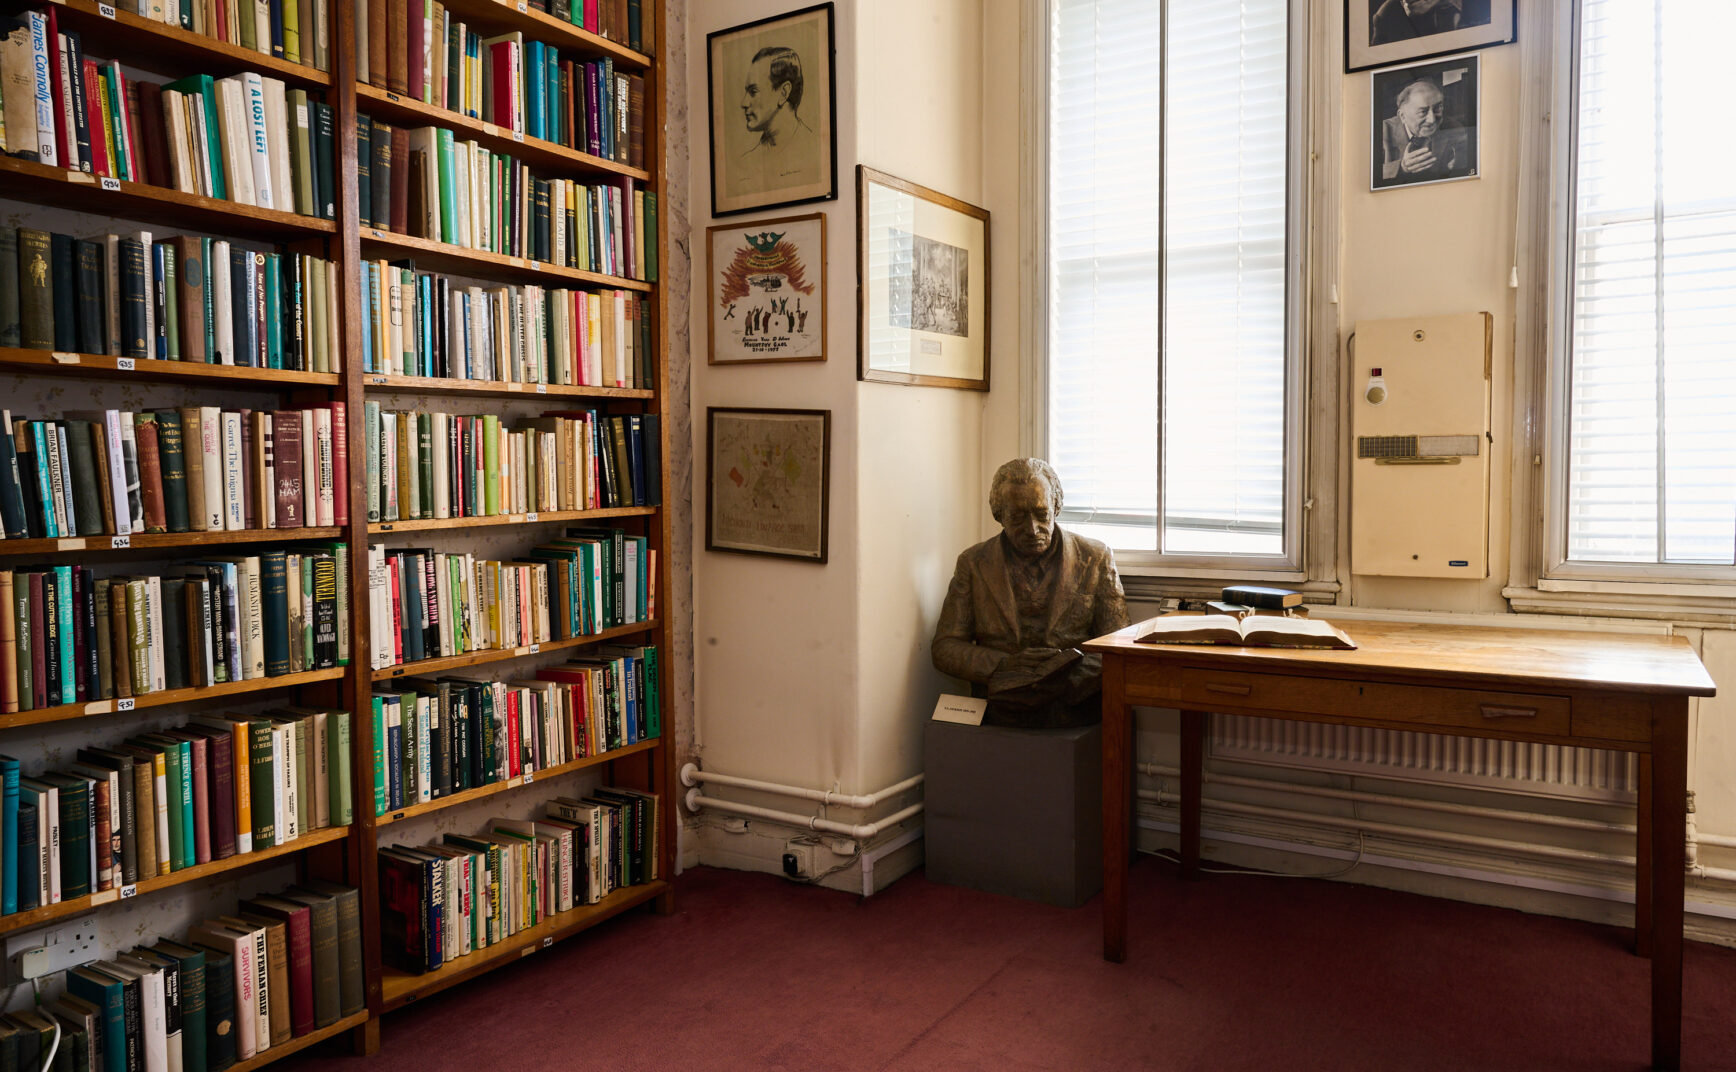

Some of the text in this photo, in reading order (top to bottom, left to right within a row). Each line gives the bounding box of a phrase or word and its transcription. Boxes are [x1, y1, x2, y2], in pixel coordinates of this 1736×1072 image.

[32, 14, 50, 103] James Connolly
[59, 50, 71, 117] ROGER CASEMENT
[251, 89, 266, 155] A LOST LEFT
[51, 455, 61, 492] FAULKNER
[228, 420, 238, 500] Garret: The Enigma
[279, 489, 300, 497] HAM
[315, 561, 336, 603] O'CONNELL
[426, 562, 434, 572] TOO
[427, 574, 435, 588] LONG
[250, 575, 260, 639] HUMANITY DICK
[432, 860, 441, 906] STALKER
[242, 947, 251, 1000] SURVIVORS
[257, 956, 265, 989] FENIAN
[259, 990, 267, 1016] CHIEF
